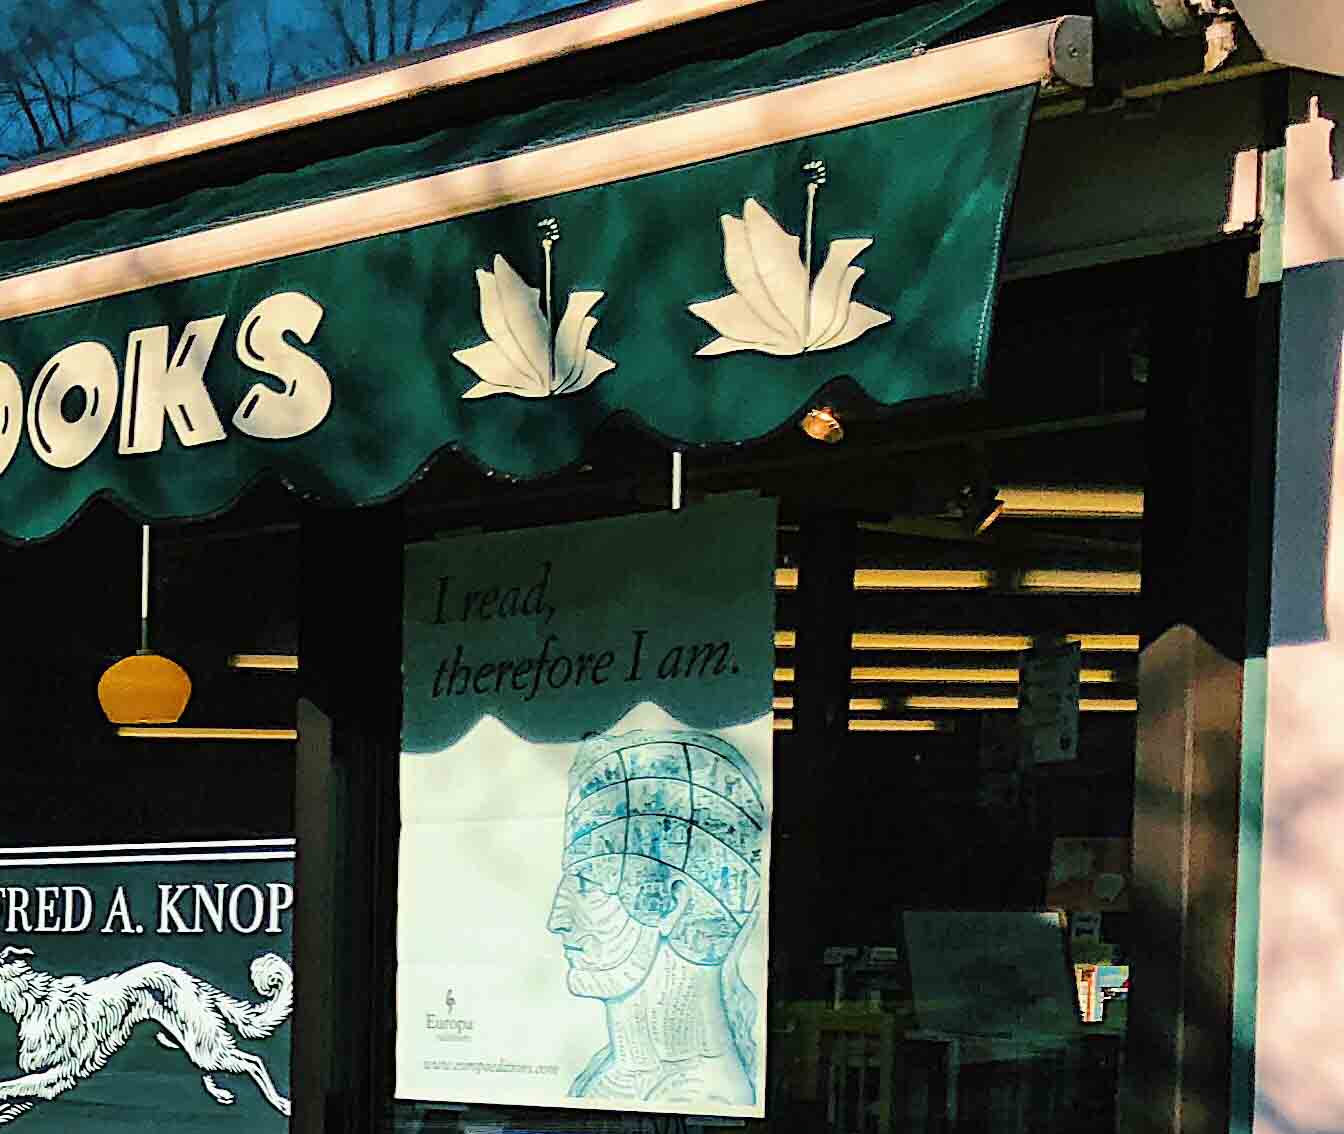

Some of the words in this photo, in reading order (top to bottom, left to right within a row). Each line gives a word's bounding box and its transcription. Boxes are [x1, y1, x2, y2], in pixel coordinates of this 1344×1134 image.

[432, 577, 449, 624] I
[462, 561, 555, 625] read,
[432, 634, 615, 702] therefore
[624, 630, 649, 682] I
[657, 641, 740, 680] am.
[100, 886, 143, 933] A.
